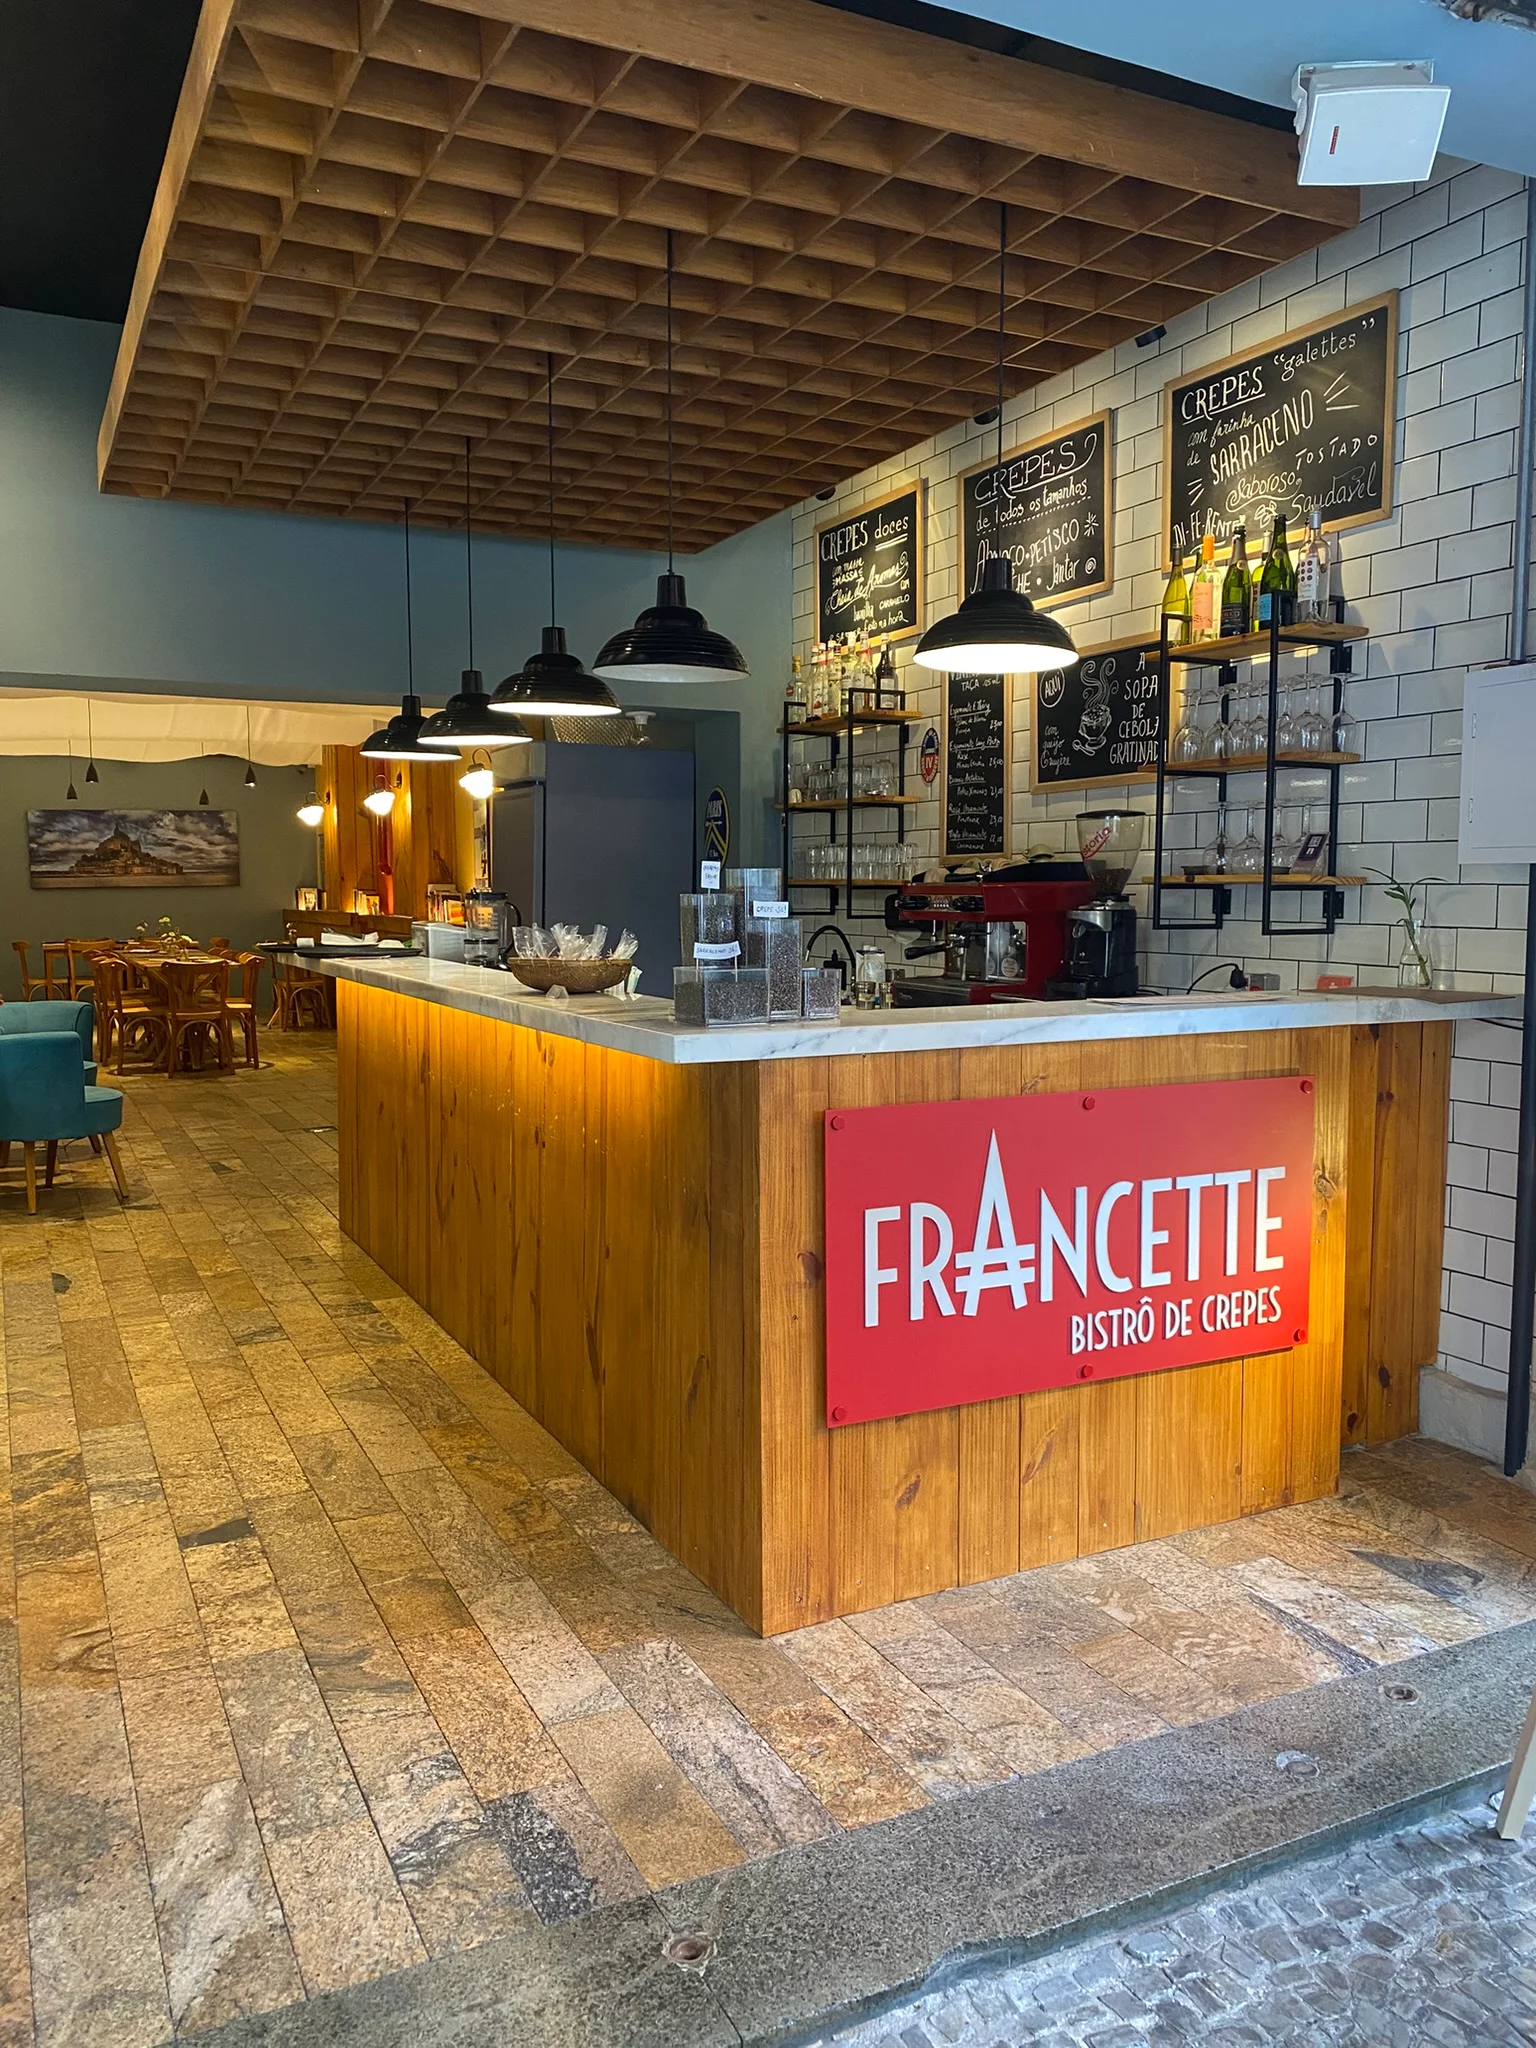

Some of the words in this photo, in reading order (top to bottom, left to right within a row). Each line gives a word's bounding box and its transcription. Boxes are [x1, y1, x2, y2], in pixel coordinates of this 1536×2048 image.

[1181, 366, 1265, 421] CREPES
[1187, 428, 1208, 448] com
[1210, 411, 1256, 448] farinha
[1187, 450, 1201, 467] de
[1210, 389, 1314, 485] SARRACENO
[1296, 434, 1378, 470] TOSTADO
[974, 441, 1077, 501] CREPES
[976, 509, 991, 532] de
[1029, 498, 1041, 512] os
[1043, 476, 1088, 507] tamanhos
[821, 519, 868, 562] CREPES
[874, 513, 909, 540] doces
[1046, 550, 1080, 591] Jantar
[1135, 651, 1146, 672] A
[1124, 674, 1159, 701] SOPA
[1132, 702, 1146, 719] DE
[864, 1128, 1286, 1328] FRANCETTE
[1071, 1296, 1155, 1354] BISTRÔ
[1165, 1298, 1193, 1340] DE
[1202, 1285, 1282, 1333] CREPES
